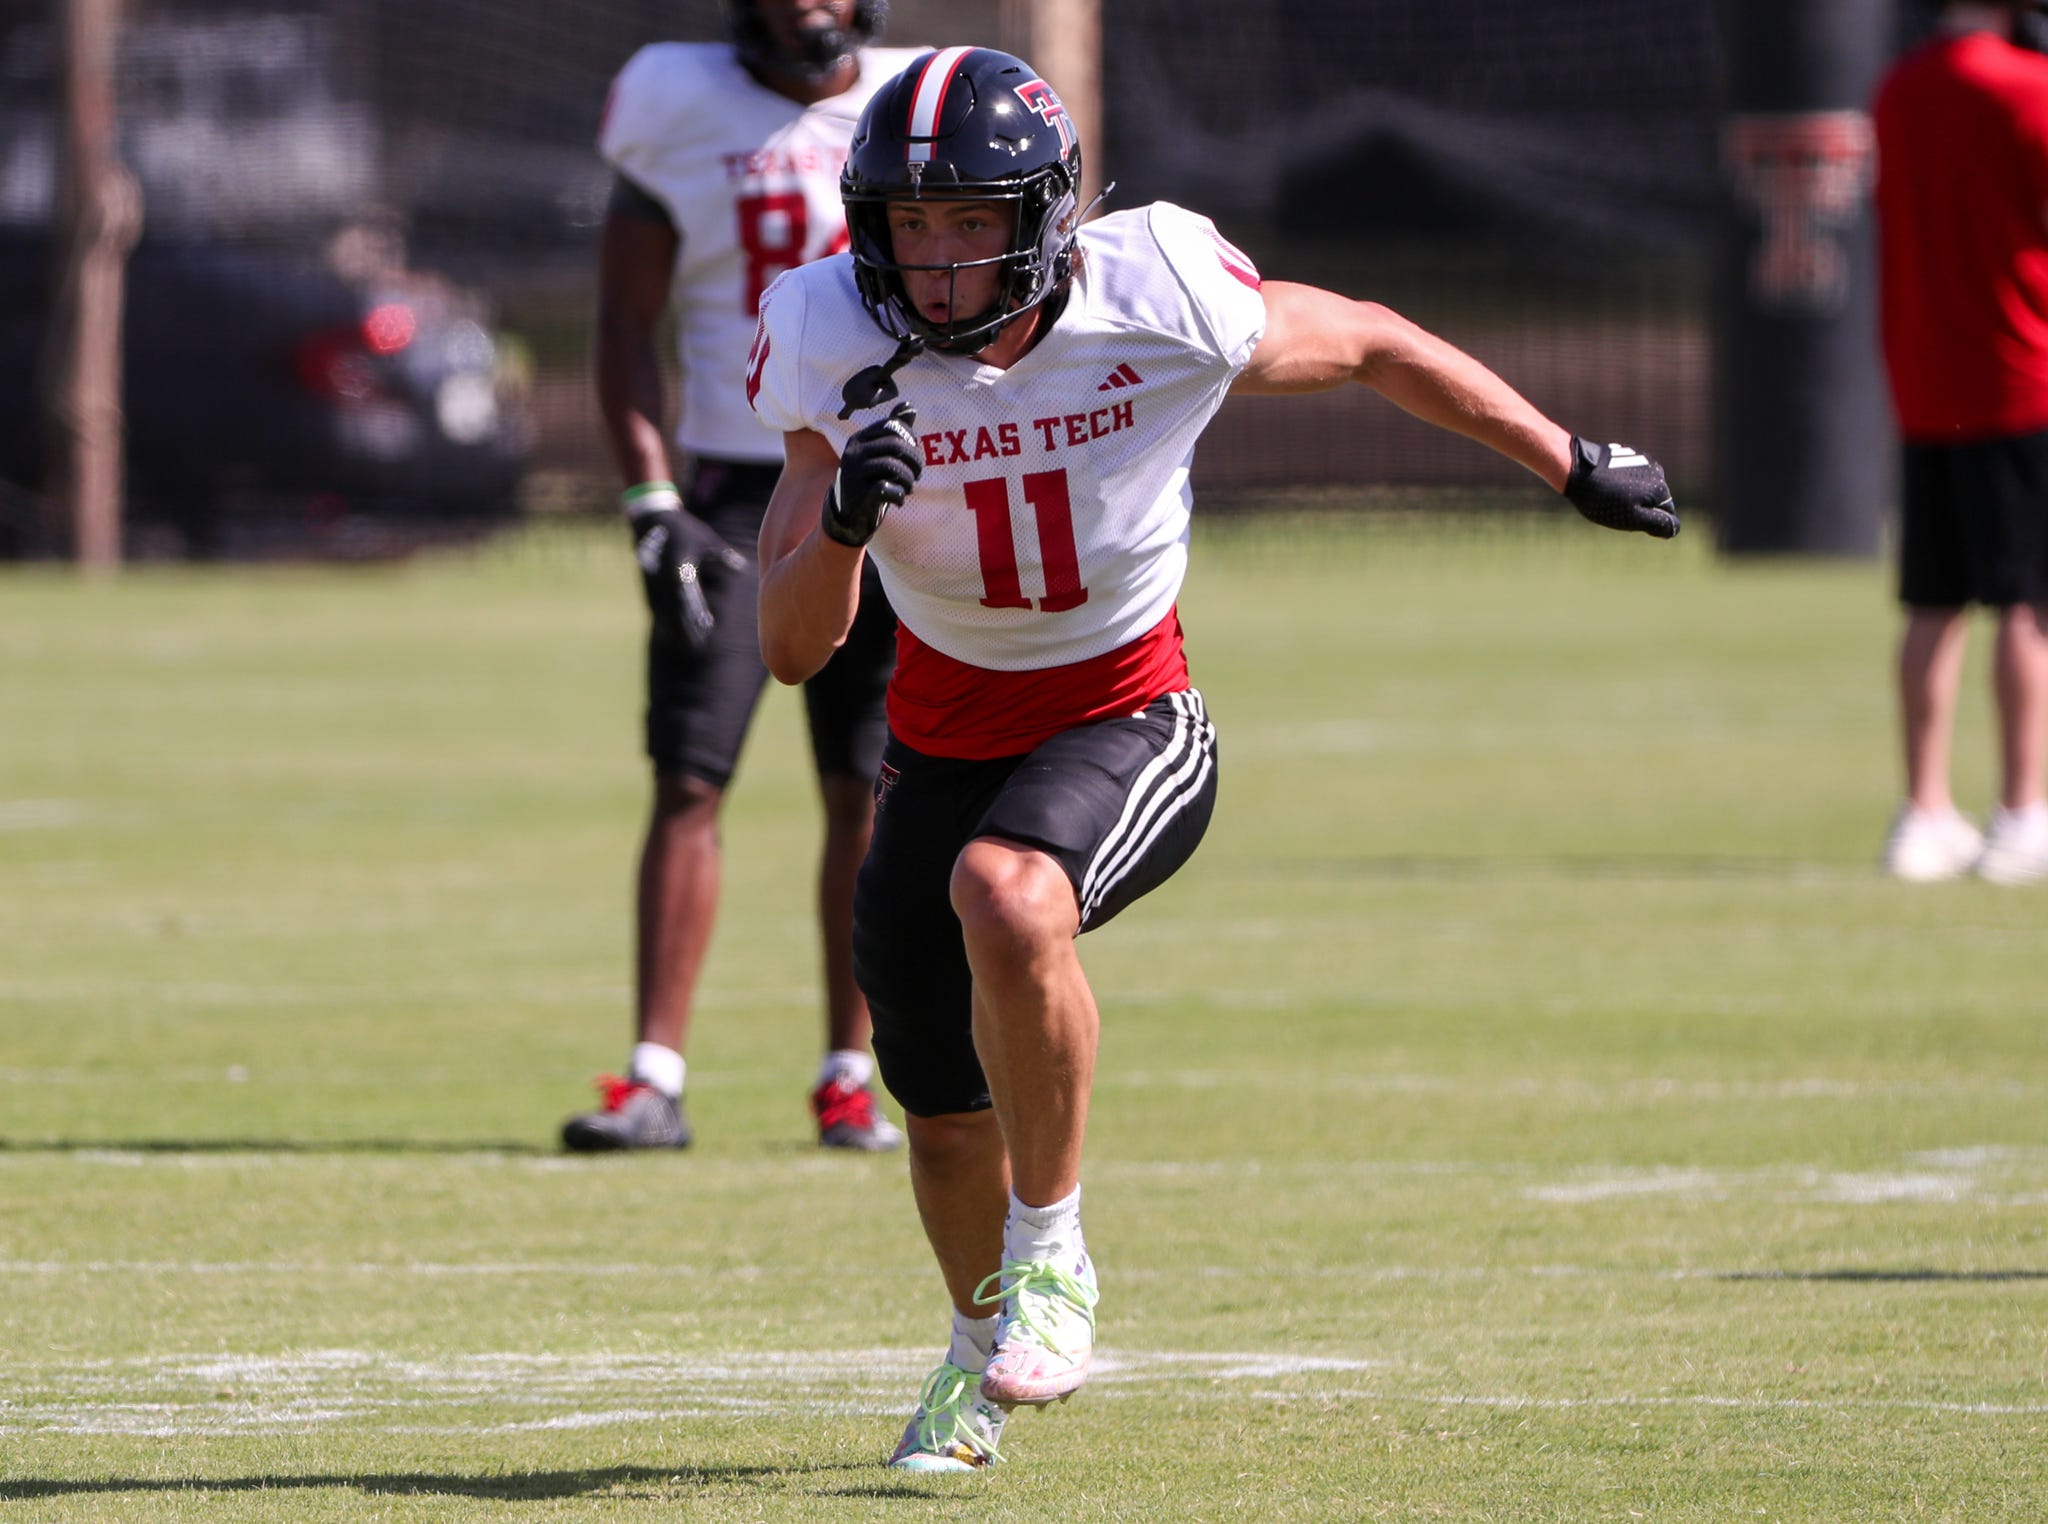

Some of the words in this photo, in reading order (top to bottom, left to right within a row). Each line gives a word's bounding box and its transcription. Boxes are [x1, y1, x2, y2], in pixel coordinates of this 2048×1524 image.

[737, 193, 851, 316] 8
[916, 422, 1021, 466] EXAS
[1033, 400, 1134, 451] TECH
[963, 468, 1088, 612] 11
